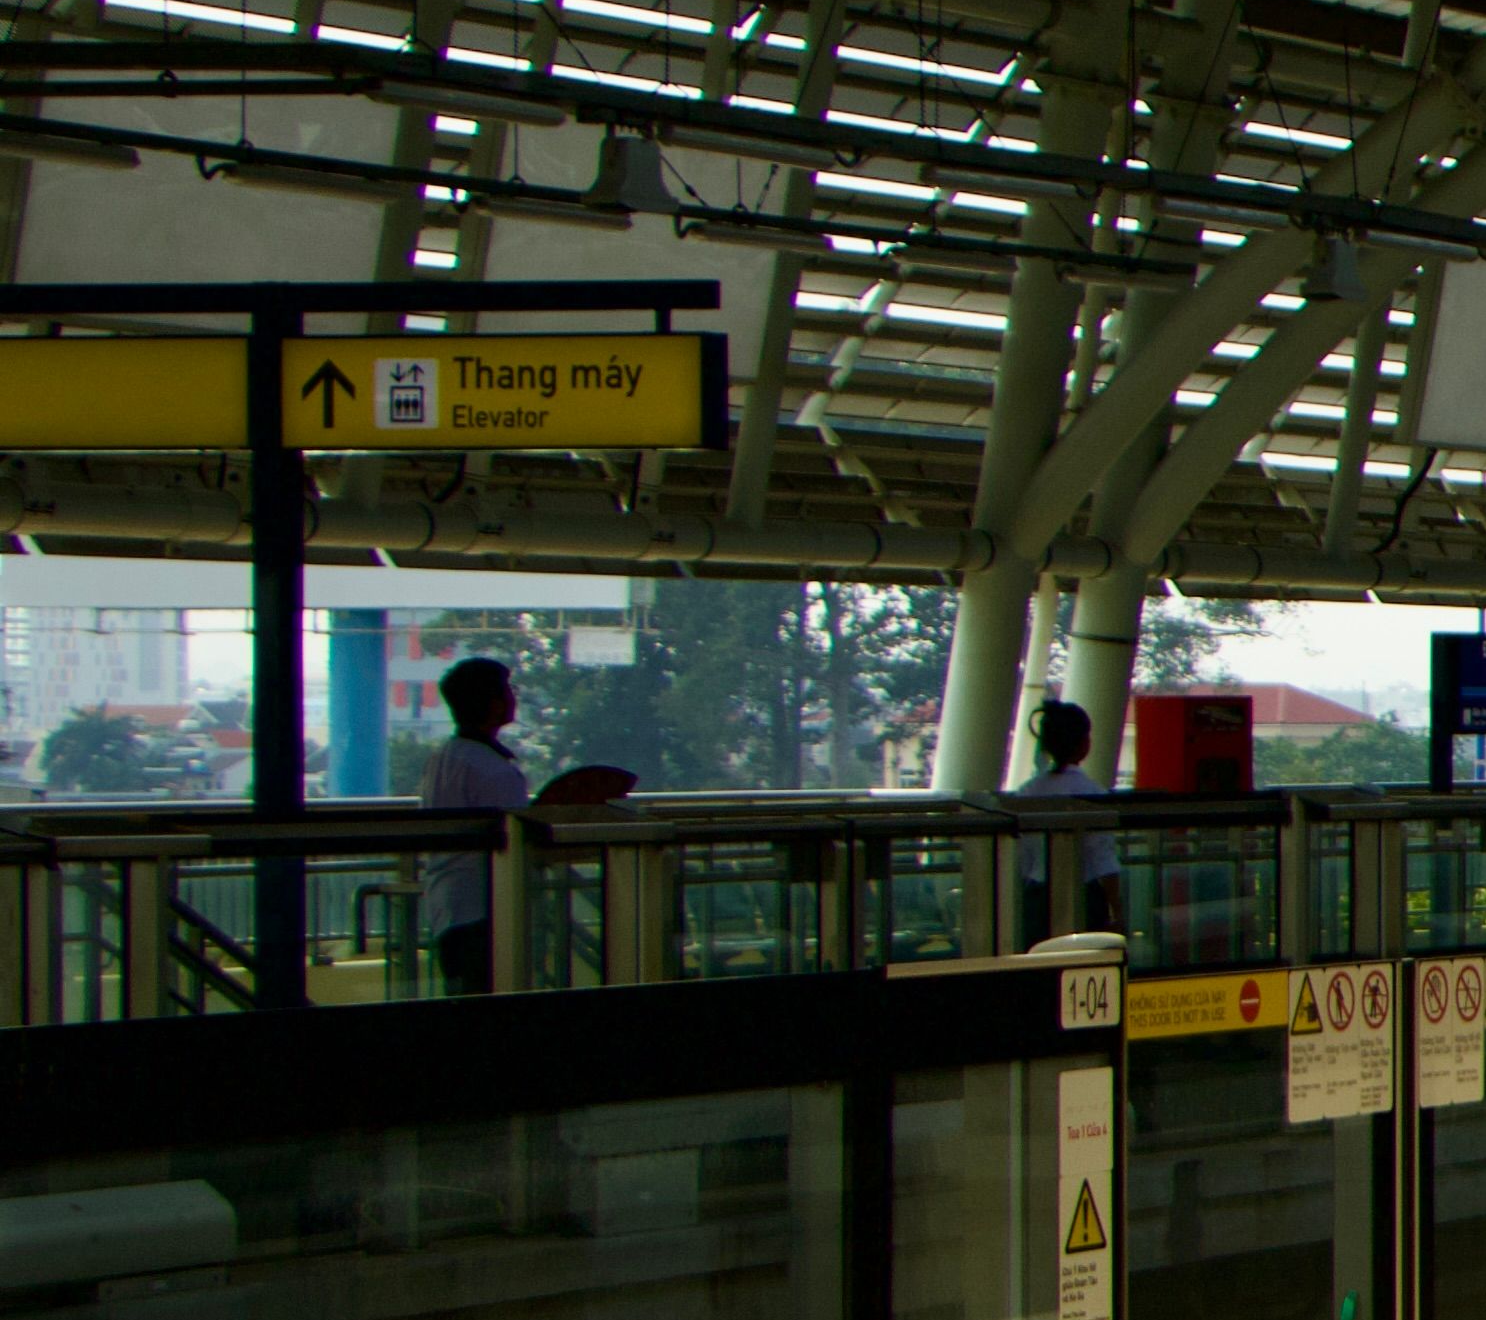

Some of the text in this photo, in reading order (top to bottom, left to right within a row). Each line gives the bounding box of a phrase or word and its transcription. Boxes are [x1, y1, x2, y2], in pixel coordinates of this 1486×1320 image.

[452, 354, 644, 398] Thang máy
[452, 404, 550, 429] Elevator
[1069, 975, 1109, 1021] 1-04
